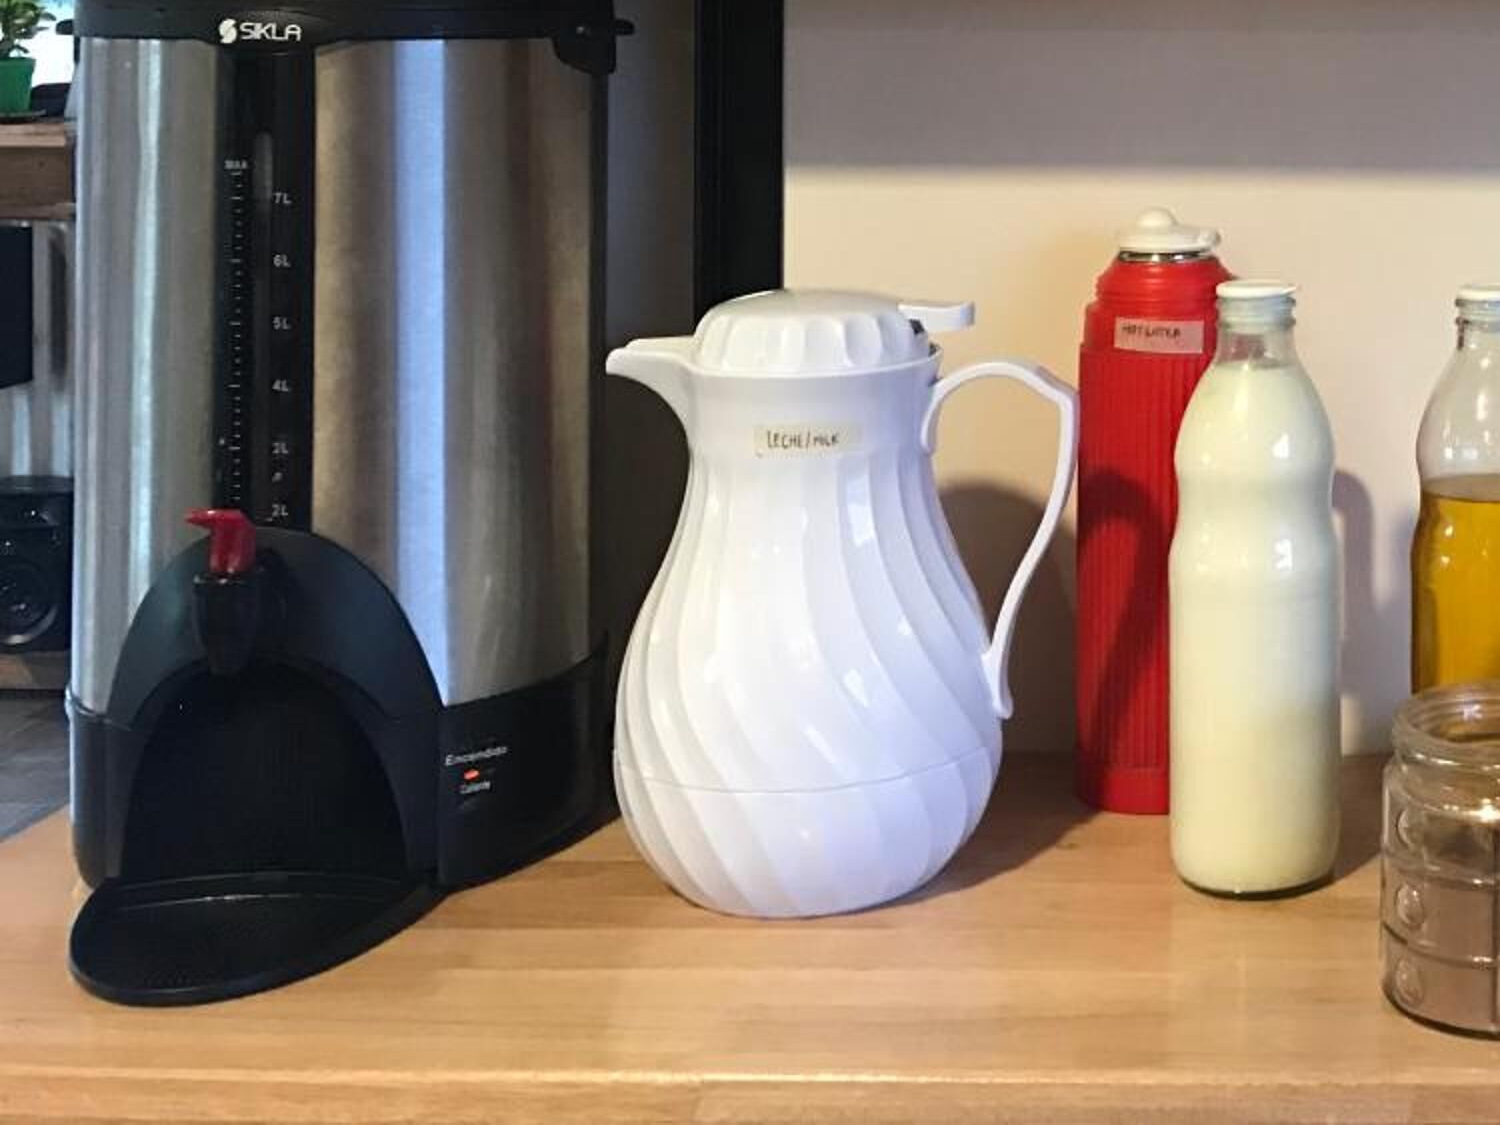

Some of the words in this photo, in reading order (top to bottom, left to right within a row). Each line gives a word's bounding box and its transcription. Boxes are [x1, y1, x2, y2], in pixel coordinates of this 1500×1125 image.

[240, 22, 302, 42] SIKLA
[274, 192, 292, 205] 7L
[273, 254, 291, 267] 6L
[272, 316, 291, 330] 5L
[272, 379, 291, 392] 4L
